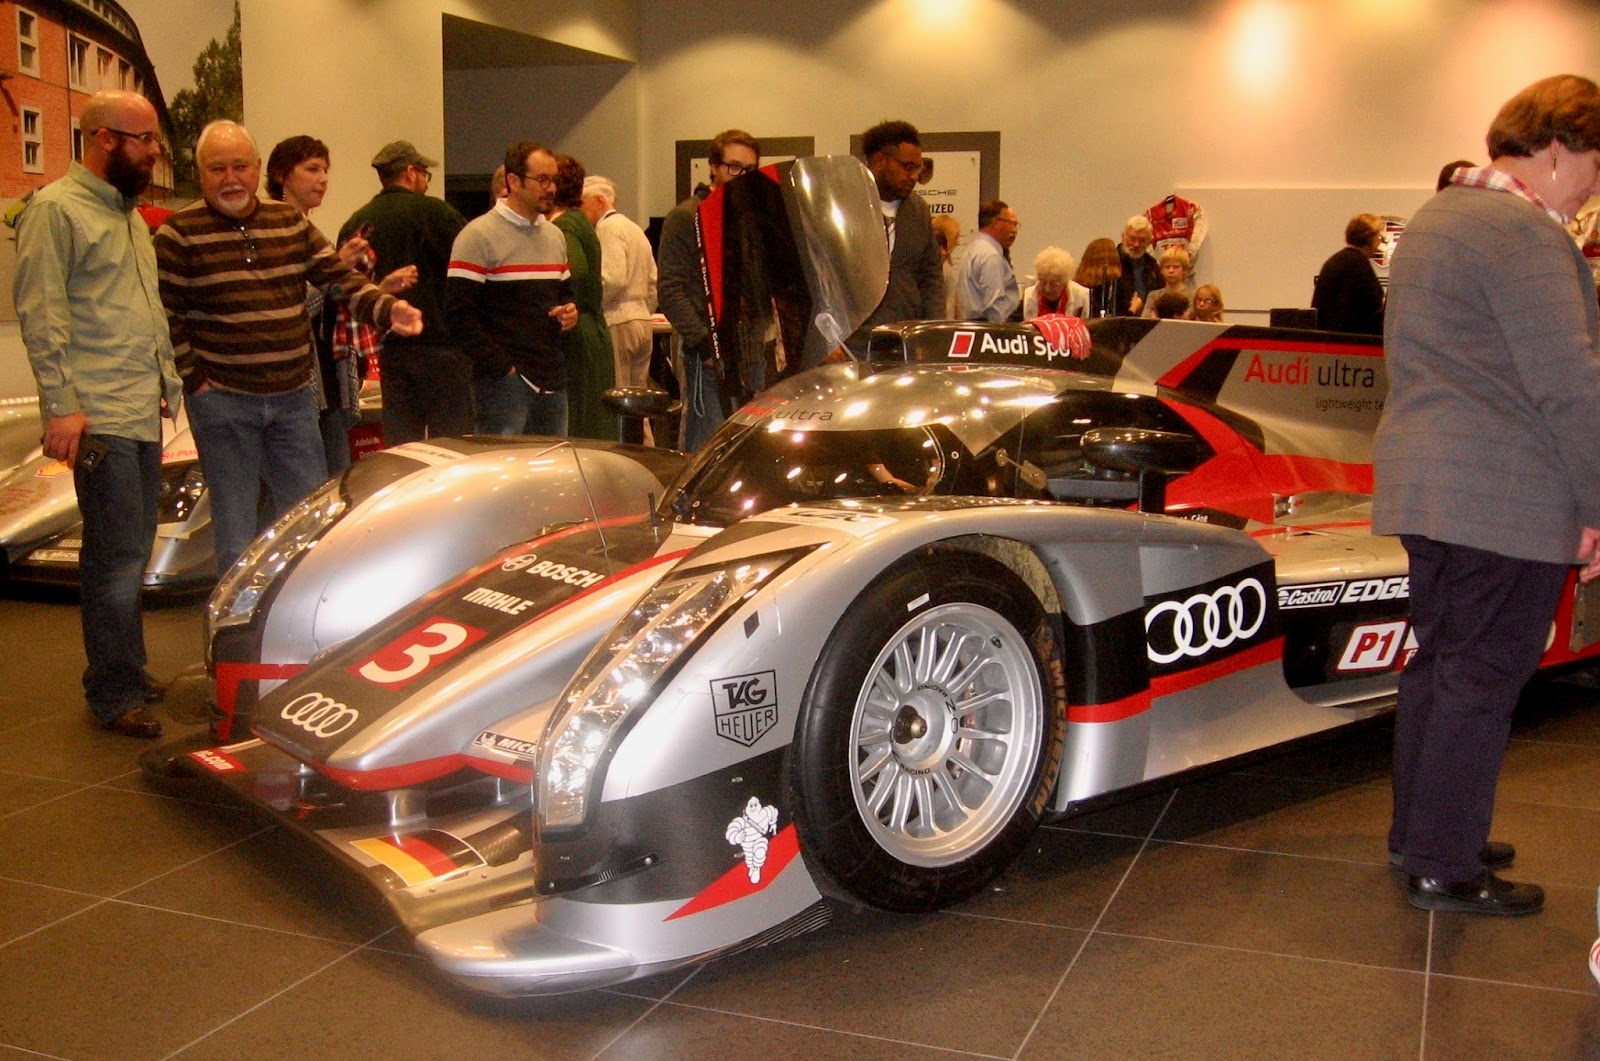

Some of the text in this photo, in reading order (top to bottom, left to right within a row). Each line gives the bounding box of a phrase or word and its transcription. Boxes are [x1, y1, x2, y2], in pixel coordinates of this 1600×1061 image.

[928, 203, 955, 213] IZED
[981, 332, 1029, 355] Audi
[1244, 354, 1375, 388] Audi ultra
[774, 408, 833, 421] ultra
[525, 560, 604, 588] BOSCH
[463, 588, 534, 615] MAHLE
[1287, 576, 1410, 606] Castrol EDGE
[358, 622, 468, 683] 3
[1350, 630, 1396, 663] P1
[722, 677, 767, 709] TAG
[721, 709, 774, 741] HEUER
